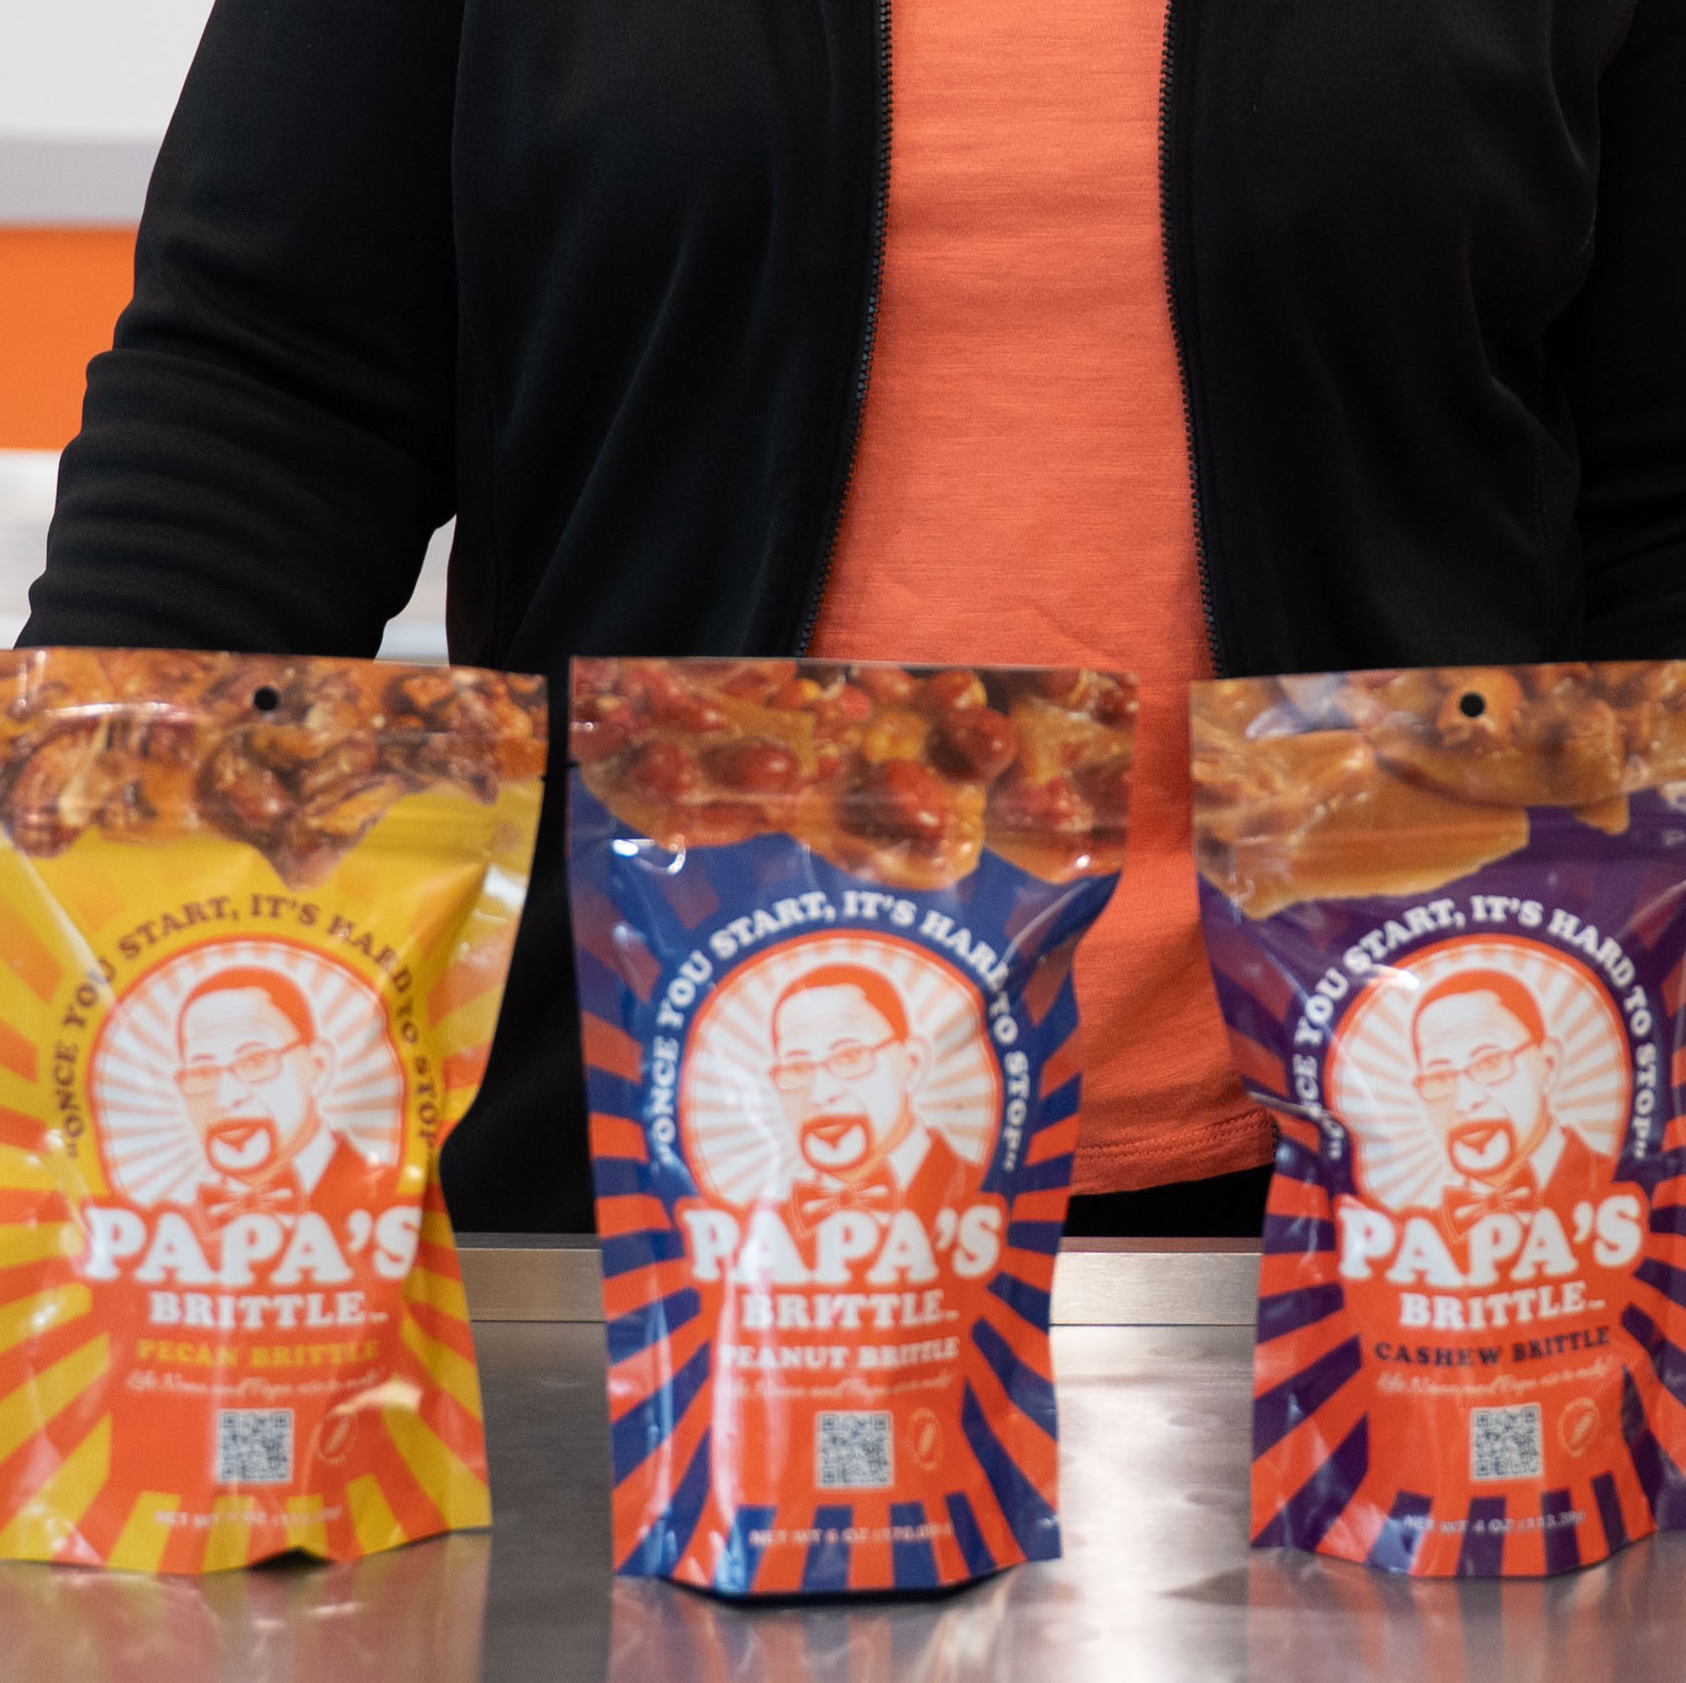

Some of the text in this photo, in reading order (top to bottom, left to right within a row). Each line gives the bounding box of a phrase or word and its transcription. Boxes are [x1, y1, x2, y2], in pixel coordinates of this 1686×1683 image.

[118, 895, 241, 959] START,
[250, 893, 320, 927] IT'S
[656, 950, 712, 1029] YOU
[709, 890, 836, 960] START,
[842, 890, 917, 926] IT'S
[1294, 967, 1349, 1047] YOU
[1342, 898, 1465, 974] START,
[1469, 895, 1544, 927] IT'S
[1547, 909, 1635, 988] HARD
[1623, 985, 1652, 1038] TO
[84, 1205, 423, 1286] PAPA'S
[682, 1204, 1002, 1285] PAPA'S
[1338, 1194, 1642, 1288] PAPA'S
[148, 1290, 365, 1330] BRITTLE
[742, 1289, 946, 1331] BRITTLE
[1399, 1280, 1587, 1331] BRITTLE
[136, 1338, 381, 1367] PECAN BRITTLE
[720, 1336, 960, 1370] PEANUT BRITTLE
[1374, 1326, 1611, 1367] CASHEW BRITTLE
